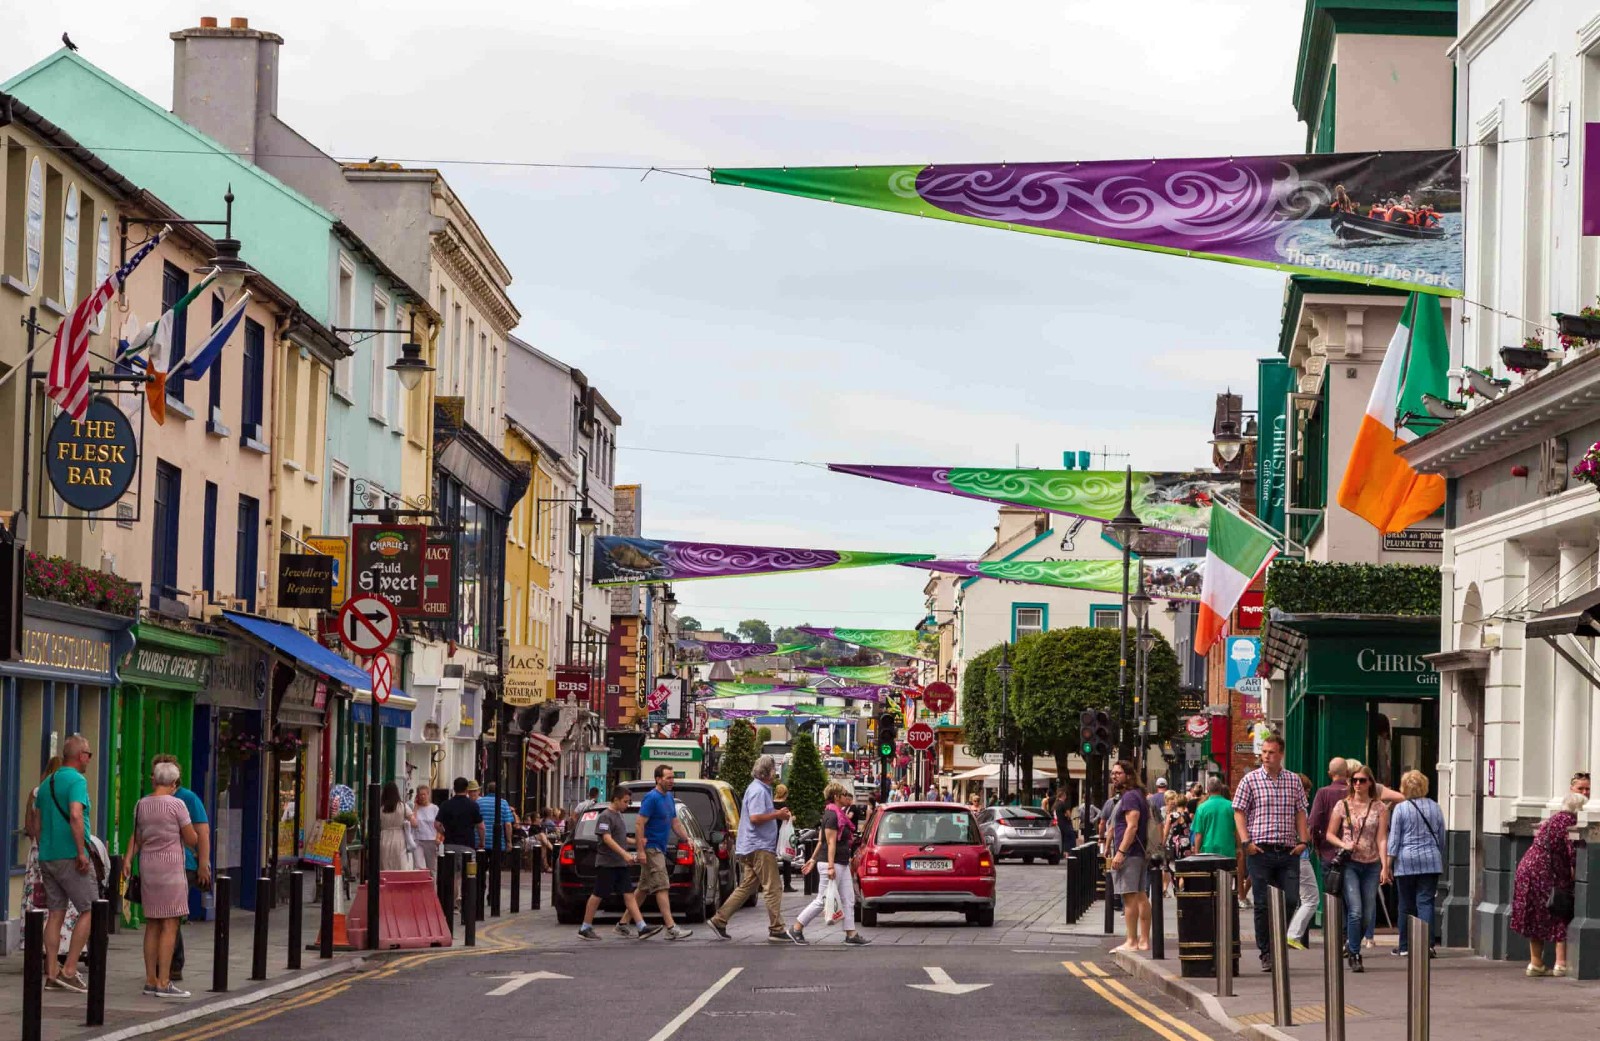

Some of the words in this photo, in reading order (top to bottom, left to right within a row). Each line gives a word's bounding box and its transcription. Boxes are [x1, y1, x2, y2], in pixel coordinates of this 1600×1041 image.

[1286, 249, 1315, 266] The
[1320, 254, 1360, 272] Town
[1363, 261, 1377, 275] in
[1380, 263, 1411, 281] The
[1415, 269, 1453, 287] Park
[71, 420, 115, 439] THE
[56, 442, 126, 464] FLESK
[1272, 414, 1286, 507] CHRISTY'S
[67, 466, 112, 486] BAR
[1263, 459, 1271, 477] Gift
[1262, 479, 1271, 501] Store
[1386, 540, 1426, 548] PLUNKETT
[282, 567, 330, 581] Jewellery
[286, 582, 325, 595] Repairs
[22, 629, 49, 665] LESK
[136, 649, 171, 676] TOURIST
[169, 655, 199, 679] OFFICE
[557, 681, 588, 691] EBS
[1416, 674, 1438, 684] Gift
[504, 687, 542, 699] ESTAURANT
[909, 731, 931, 742] STOP
